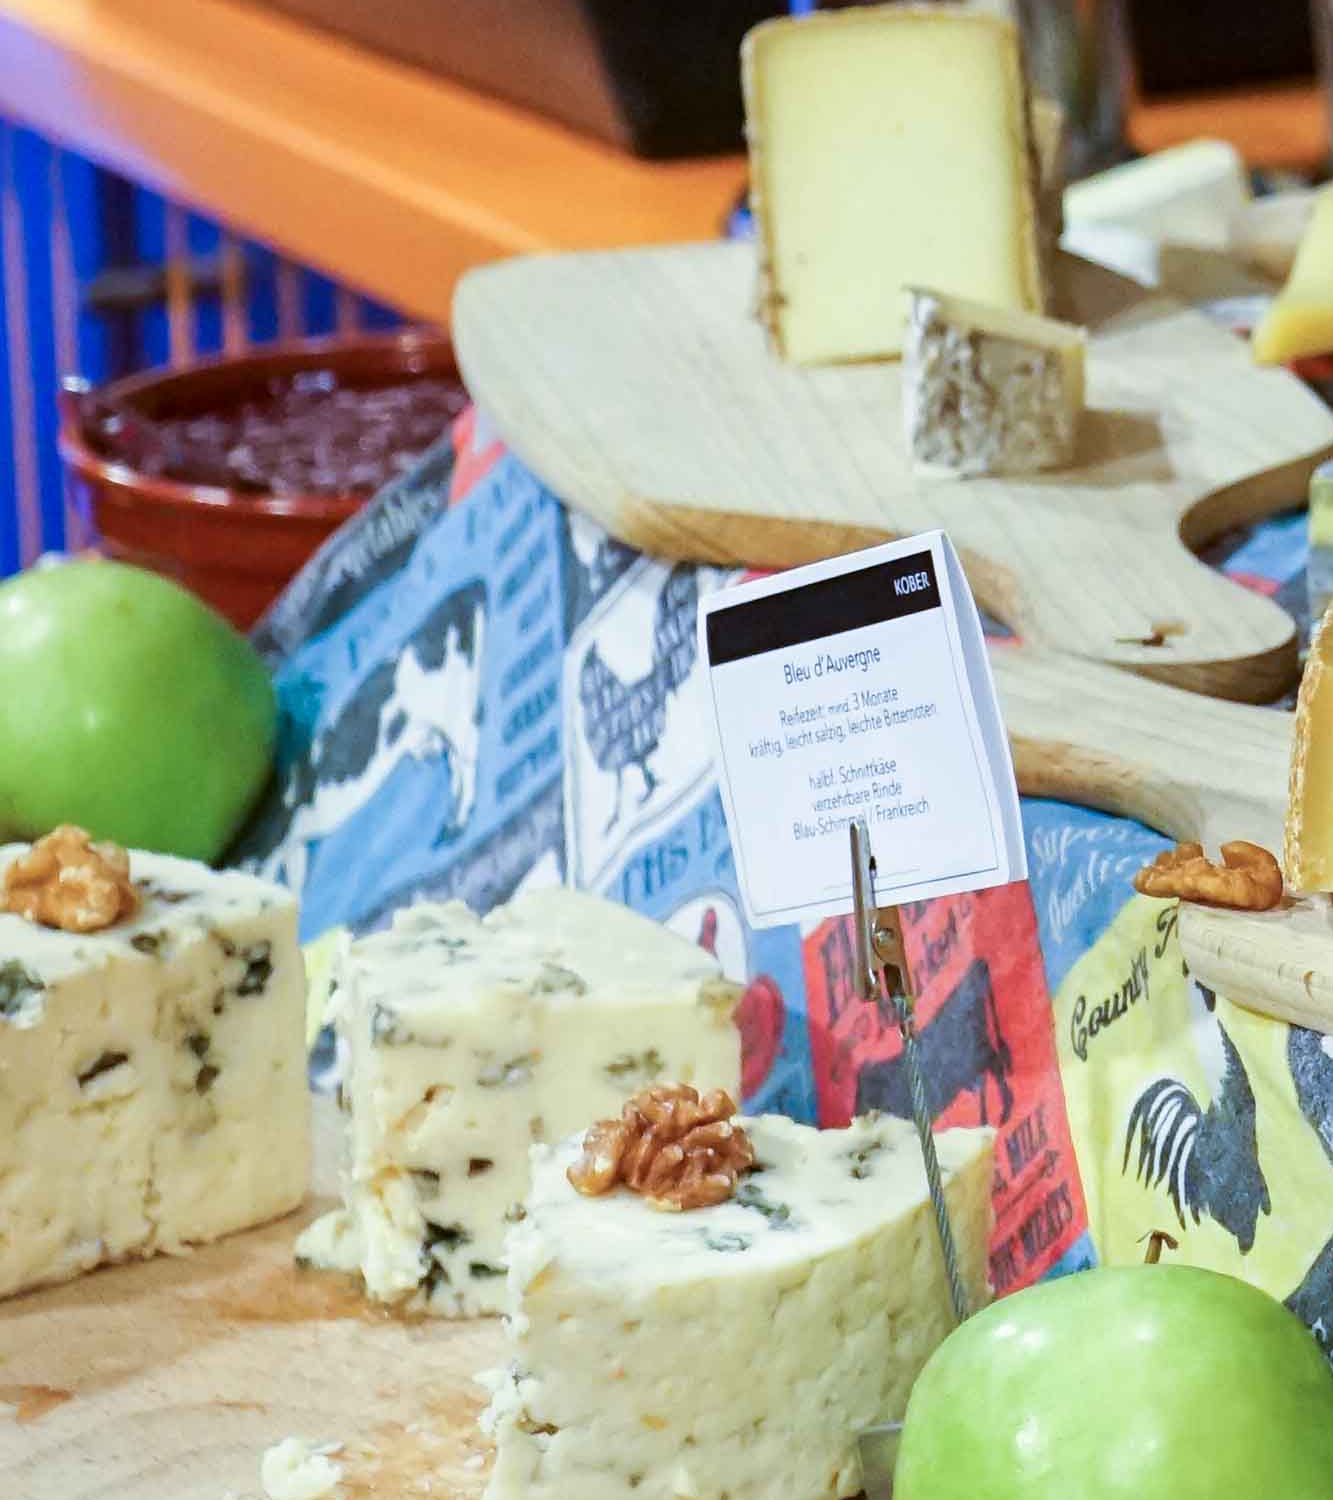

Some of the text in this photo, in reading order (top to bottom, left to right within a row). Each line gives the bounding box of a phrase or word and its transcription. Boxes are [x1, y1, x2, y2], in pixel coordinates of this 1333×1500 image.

[894, 571, 930, 596] KOBER
[784, 664, 811, 685] Bleu
[861, 688, 899, 708] Monate
